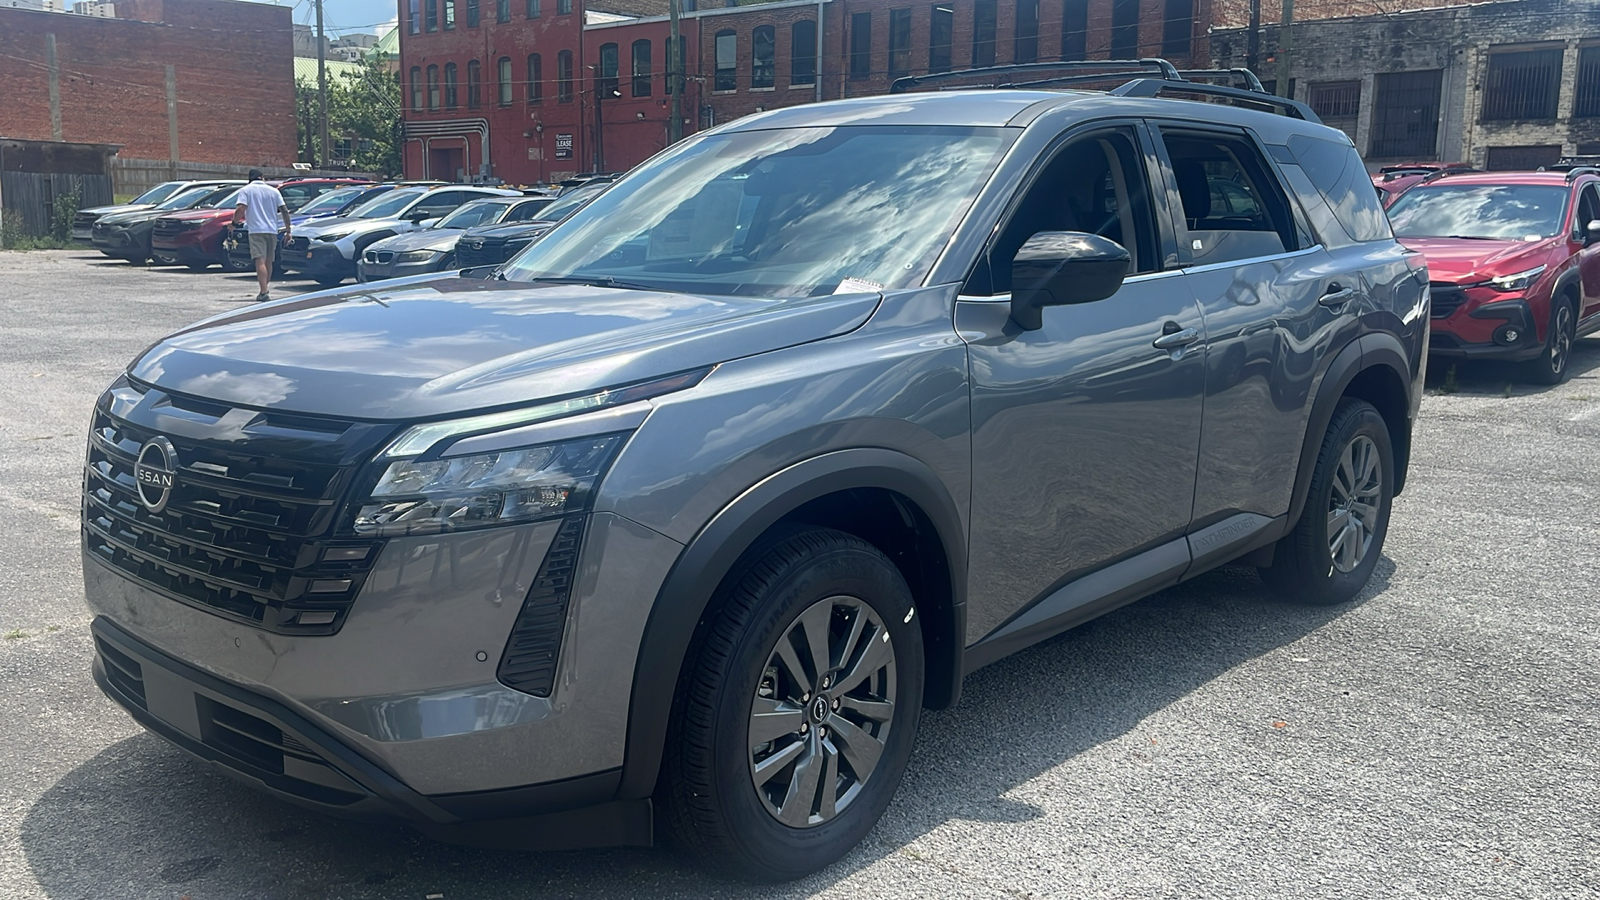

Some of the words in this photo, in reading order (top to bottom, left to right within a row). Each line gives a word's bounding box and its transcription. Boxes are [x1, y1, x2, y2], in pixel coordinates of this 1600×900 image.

[329, 159, 348, 167] TRUST
[139, 469, 172, 487] SSAN
[1193, 516, 1257, 551] PATHFINDER
